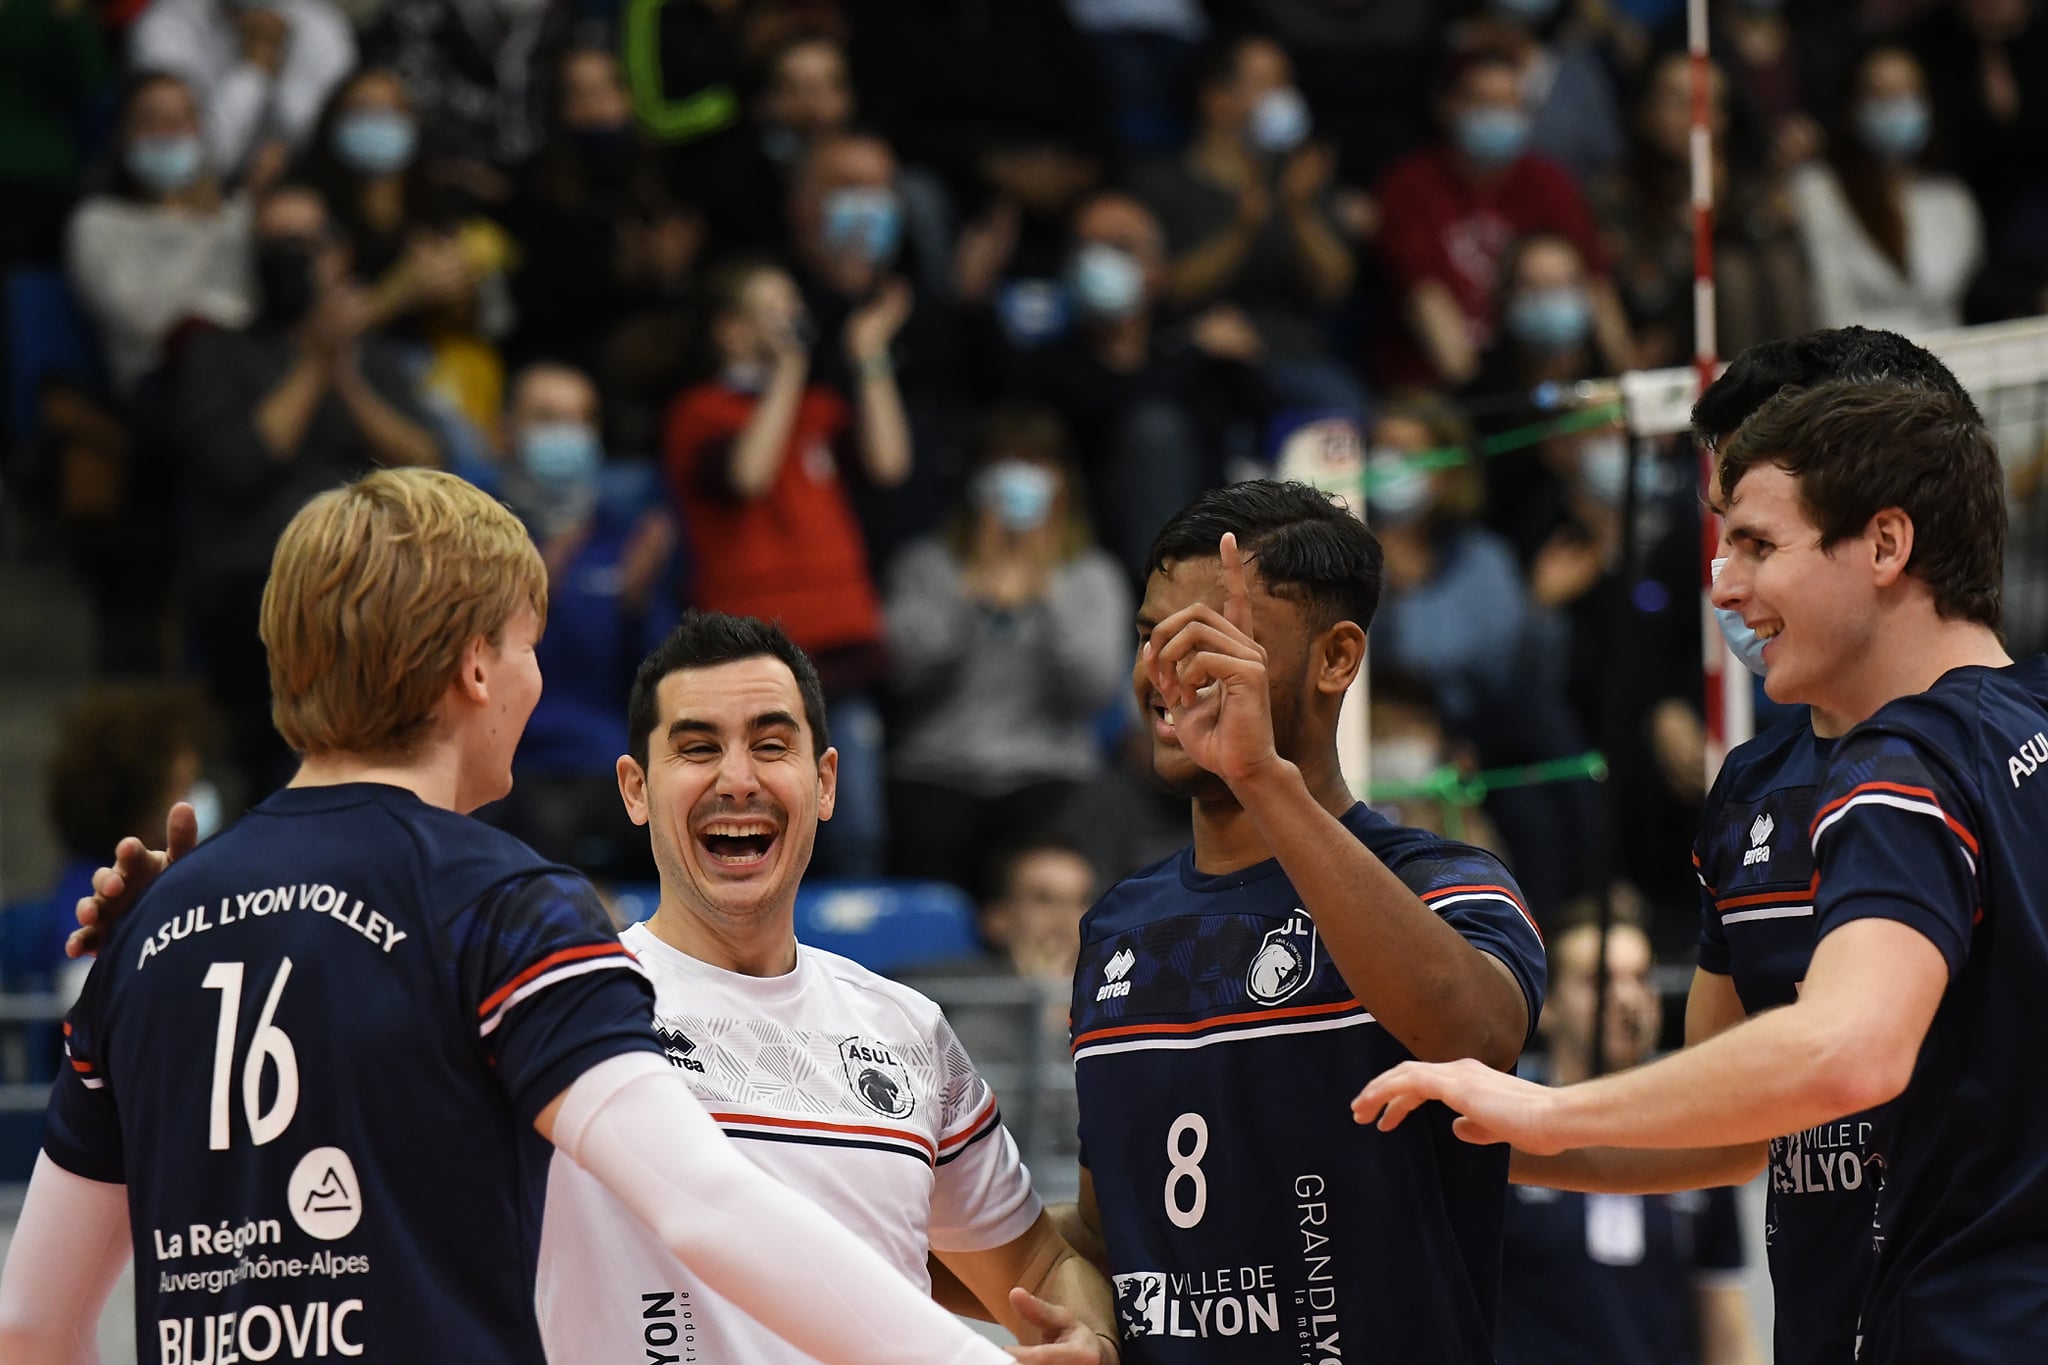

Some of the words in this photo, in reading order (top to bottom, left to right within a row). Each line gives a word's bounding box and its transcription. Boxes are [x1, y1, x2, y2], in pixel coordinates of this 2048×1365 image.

[137, 907, 213, 971] ASUL
[220, 885, 297, 925] LYON
[299, 884, 408, 953] VOLLEY
[201, 956, 299, 1150] 16
[667, 1053, 706, 1074] rrea
[849, 1045, 898, 1066] ASUL
[1803, 1123, 1851, 1150] VILLE
[1164, 1112, 1209, 1229] 8
[153, 1229, 183, 1260] La
[189, 1217, 282, 1259] Régon
[158, 1250, 370, 1293] Auvergnhône-Alpes
[1170, 1268, 1233, 1296] VILLE
[1240, 1265, 1276, 1290] DE
[1169, 1292, 1280, 1338] LYON
[1294, 1290, 1306, 1304] la
[1297, 1316, 1313, 1365] métr
